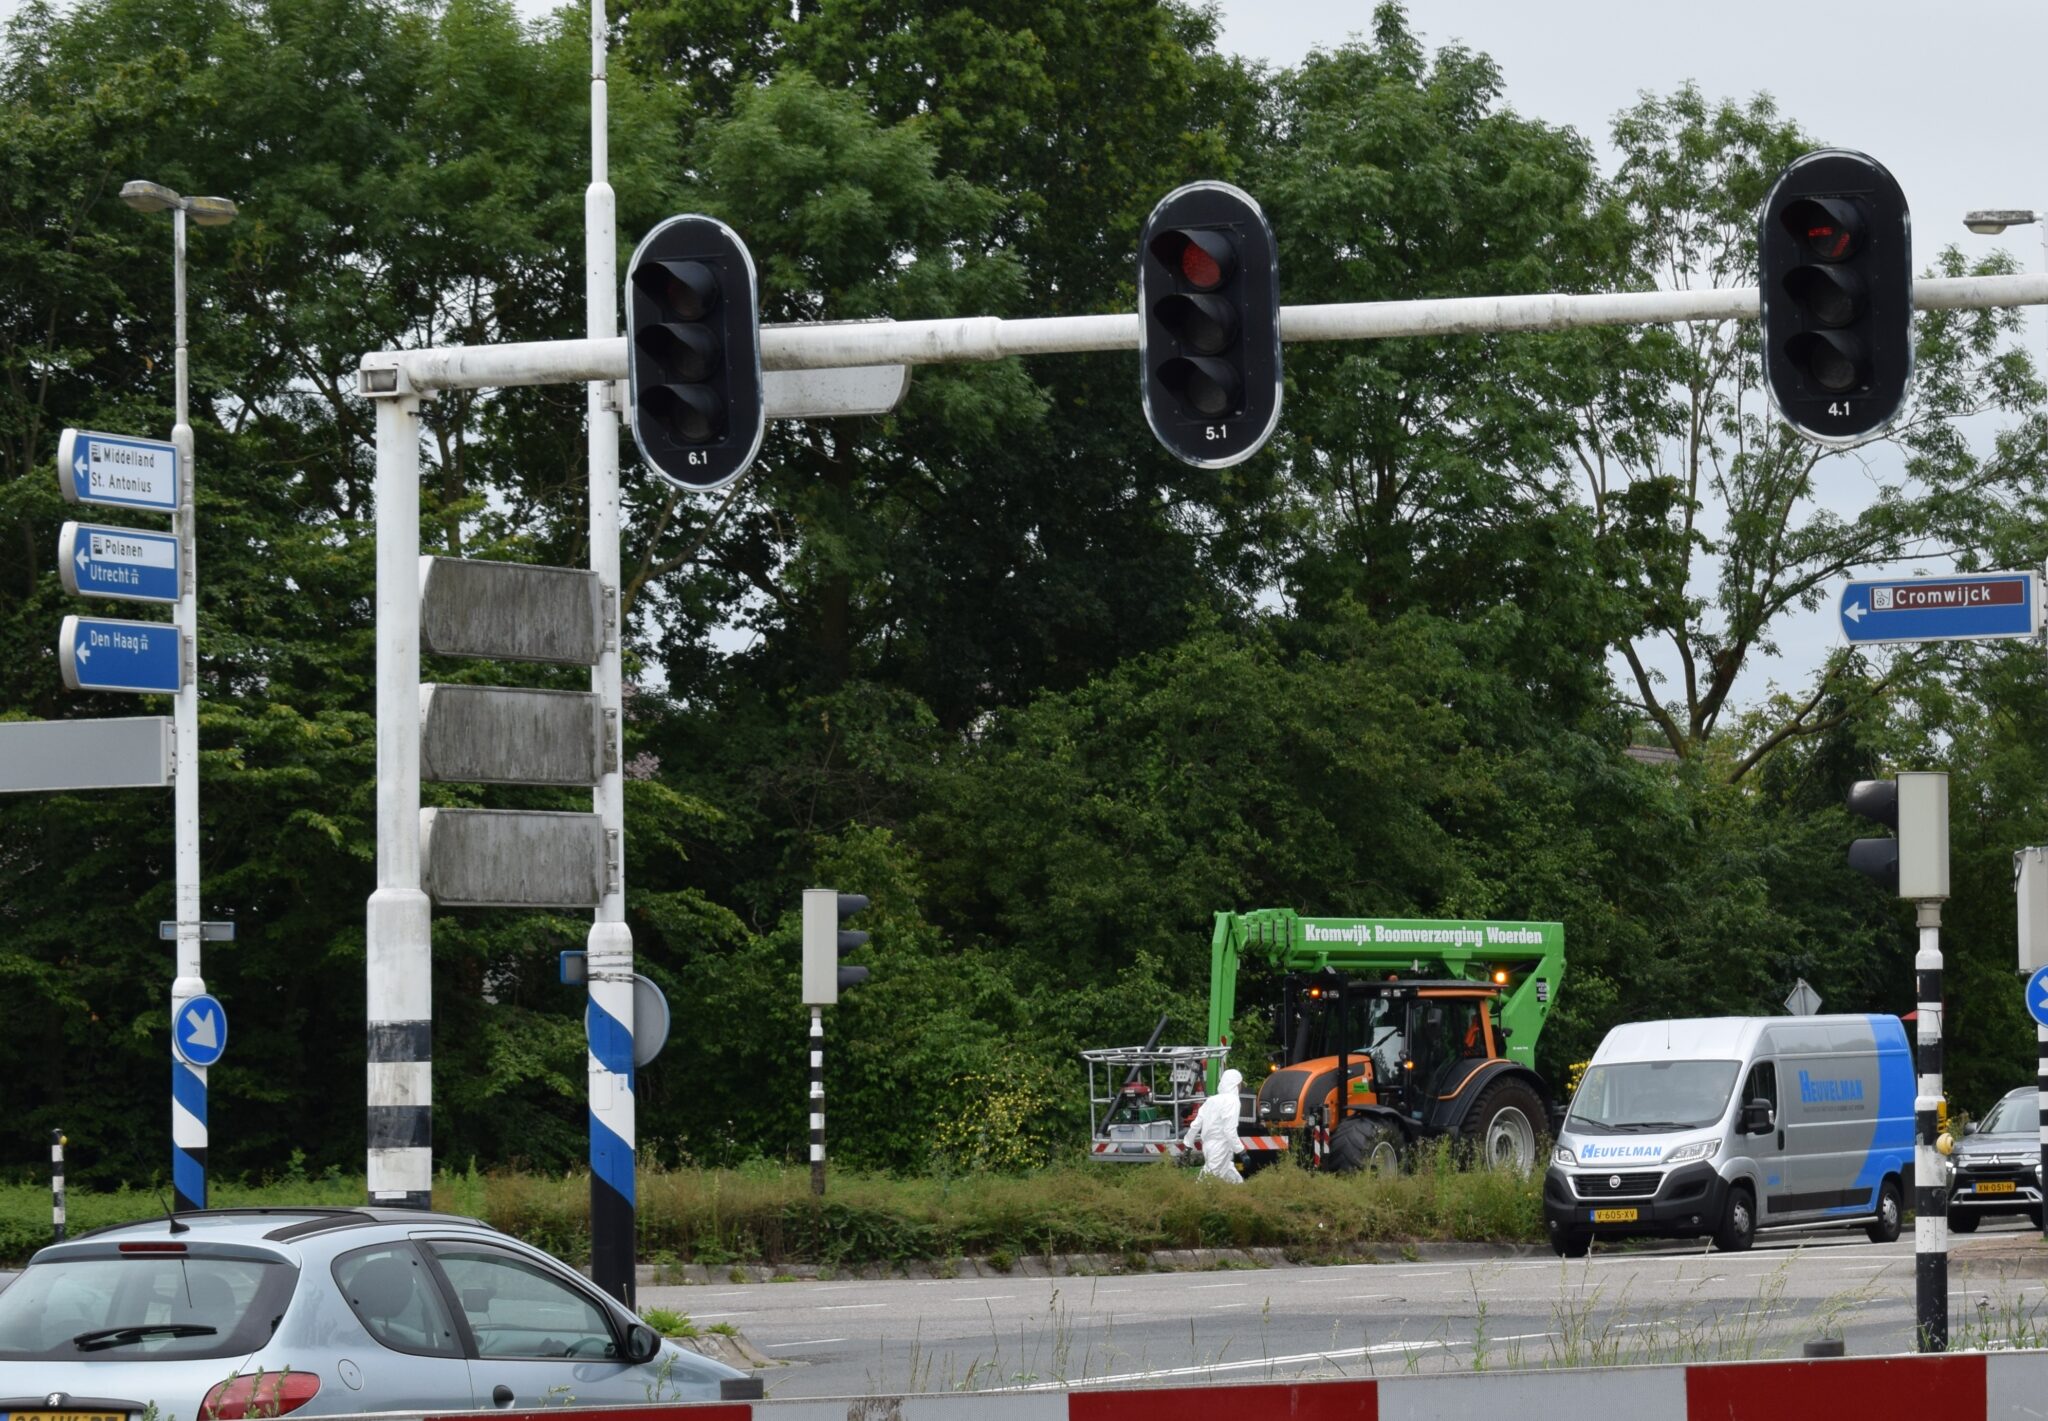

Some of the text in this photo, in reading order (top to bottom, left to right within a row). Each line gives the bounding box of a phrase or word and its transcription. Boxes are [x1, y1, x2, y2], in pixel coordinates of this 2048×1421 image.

[1828, 401, 1850, 416] 4.1
[1205, 424, 1227, 440] 5.1
[103, 447, 155, 468] Middelland
[688, 450, 708, 466] 6.1
[91, 471, 152, 493] St. Antonius
[105, 539, 143, 558] Polanen
[90, 563, 129, 584] Utrecht
[1895, 585, 1991, 607] Cromwijck
[90, 629, 139, 655] Den Haag
[1305, 924, 1543, 948] Kromwijk Boomverzorging Woerden
[1581, 1143, 1662, 1159] HEUVELMAN
